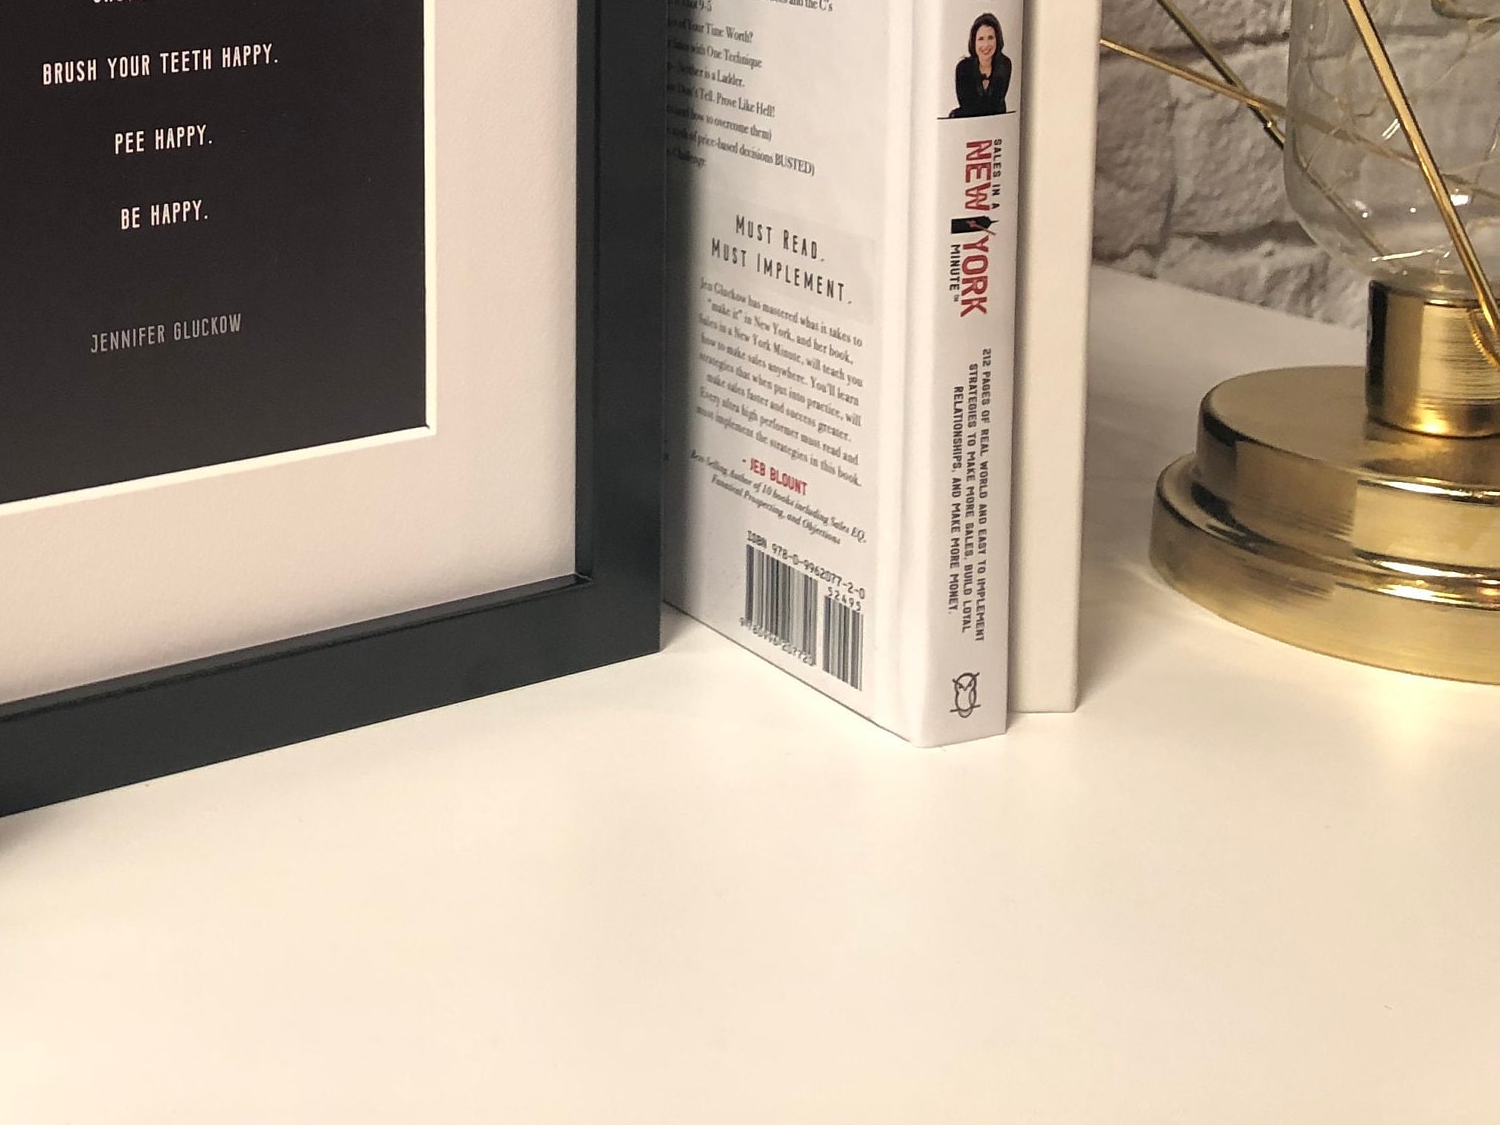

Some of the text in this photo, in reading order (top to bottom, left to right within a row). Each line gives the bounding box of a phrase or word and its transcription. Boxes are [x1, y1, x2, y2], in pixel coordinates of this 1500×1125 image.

[706, 22, 754, 42] Time Worth?
[42, 42, 278, 86] BRUSH YOUR TEETH HAPPY.
[706, 45, 722, 60] One
[724, 48, 762, 69] Technique
[716, 91, 738, 109] Prove
[738, 96, 756, 113] Like
[756, 100, 776, 117] Hell!
[114, 124, 212, 154] PEE HAPPY.
[714, 118, 750, 134] overcome
[740, 143, 774, 164] decisions
[774, 152, 816, 175] BUSTED)
[991, 138, 1002, 210] SALES IN A
[120, 198, 208, 230] BE HAPPY.
[960, 139, 993, 318] NEW YORK
[736, 215, 825, 261] MUST READ.
[712, 238, 852, 304] MUST IMPLEMENT.
[949, 244, 961, 291] MINUTE
[90, 313, 241, 353] JENNIFER GLUCKOW
[796, 335, 812, 348] and
[812, 338, 828, 355] her
[828, 324, 850, 343] takes
[852, 333, 862, 348] to
[838, 387, 860, 407] learn
[846, 376, 864, 389] you
[967, 363, 978, 428] STRATEGIES
[967, 433, 977, 446] TO
[842, 452, 858, 466] and
[966, 451, 976, 481] MAKE
[749, 456, 808, 497] JEB BLOUNT
[952, 477, 962, 498] AND
[965, 487, 975, 517] MORE
[975, 348, 992, 642] 212 PAGES OF REAL WORLD AND EASY TO IMPLEMENT
[951, 503, 961, 533] MAKE
[949, 538, 960, 568] MORE
[963, 564, 974, 595] BUILD
[961, 600, 972, 633] LOYAL
